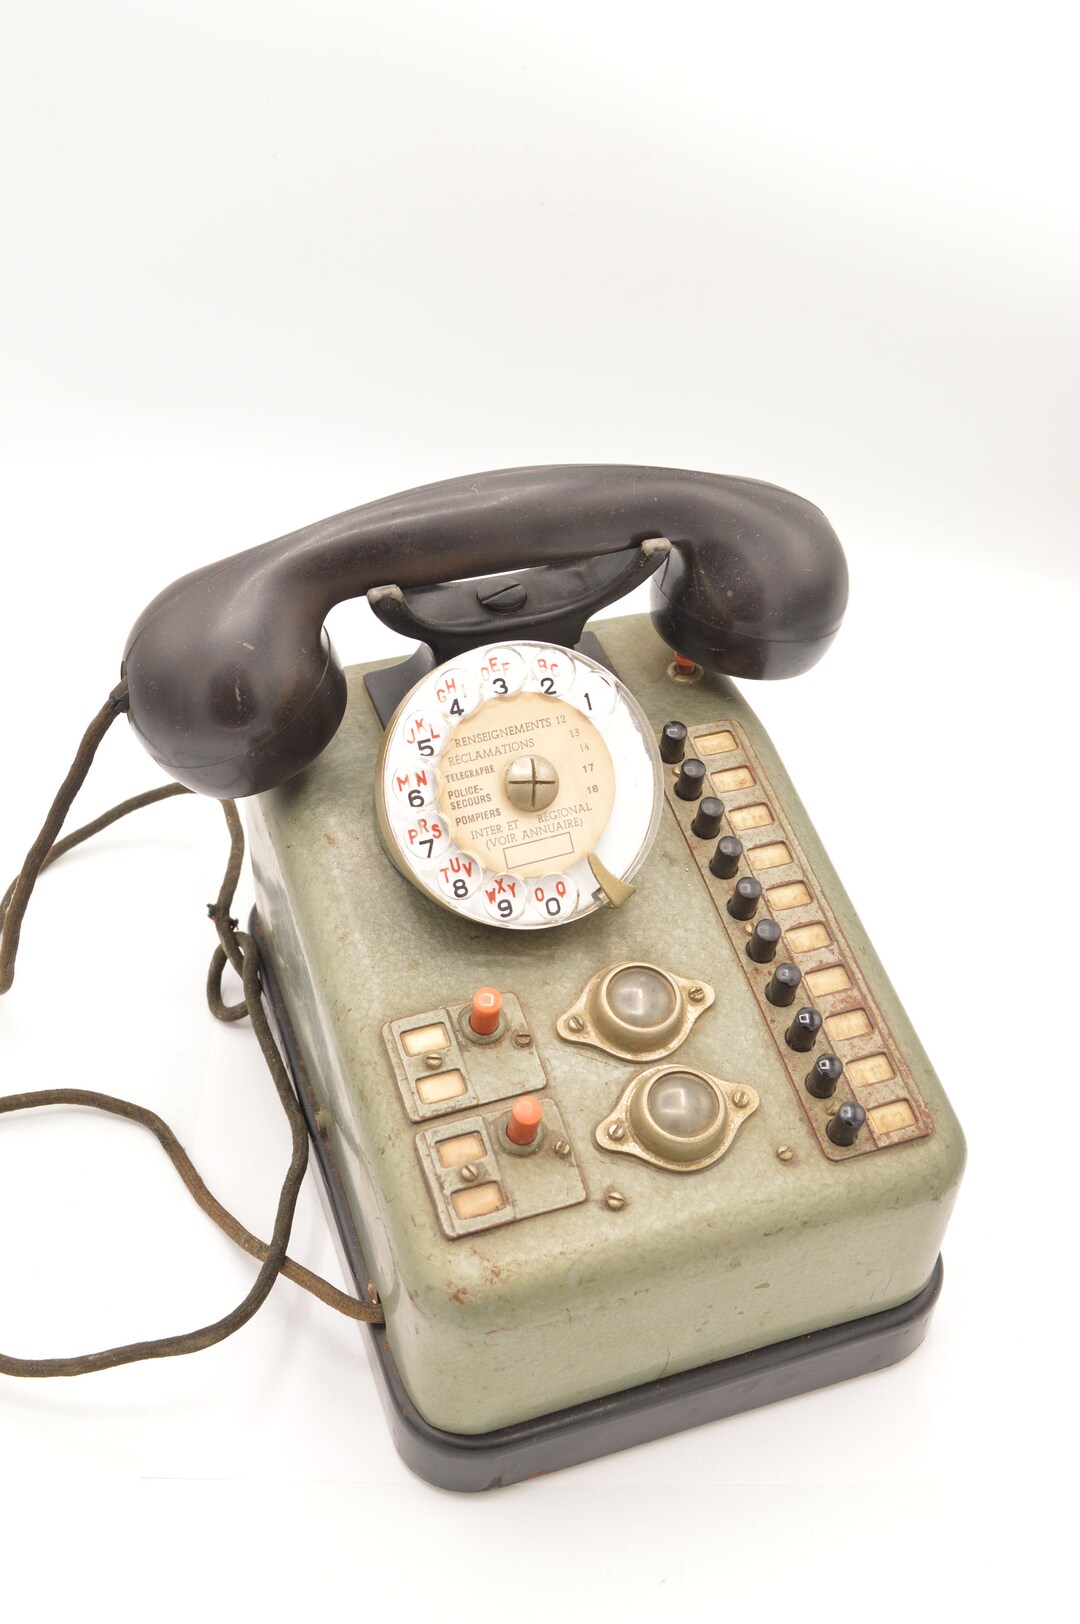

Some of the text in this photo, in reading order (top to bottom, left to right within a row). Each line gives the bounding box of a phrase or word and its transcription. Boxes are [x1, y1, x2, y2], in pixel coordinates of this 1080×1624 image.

[492, 677, 509, 695] 3
[540, 677, 557, 695] 2
[449, 698, 465, 716] 4
[583, 692, 593, 711] 1
[455, 714, 568, 748] RENSEIGNEMENTS 12
[417, 738, 435, 757] 5
[448, 728, 581, 766] RÉCLAMATIONS 13
[445, 743, 590, 784] TELEGRAPHE 14
[447, 784, 484, 800] POLICE-
[450, 763, 595, 811] SECOURS 17
[407, 789, 425, 808] 6
[455, 784, 599, 827] POMPIERS 18
[470, 802, 593, 840] INTER ET RÉGIONAL
[485, 818, 584, 851] (VOIR ANNUAIRE)
[419, 838, 434, 858] 7
[452, 879, 469, 898] 8
[497, 899, 513, 918] 9
